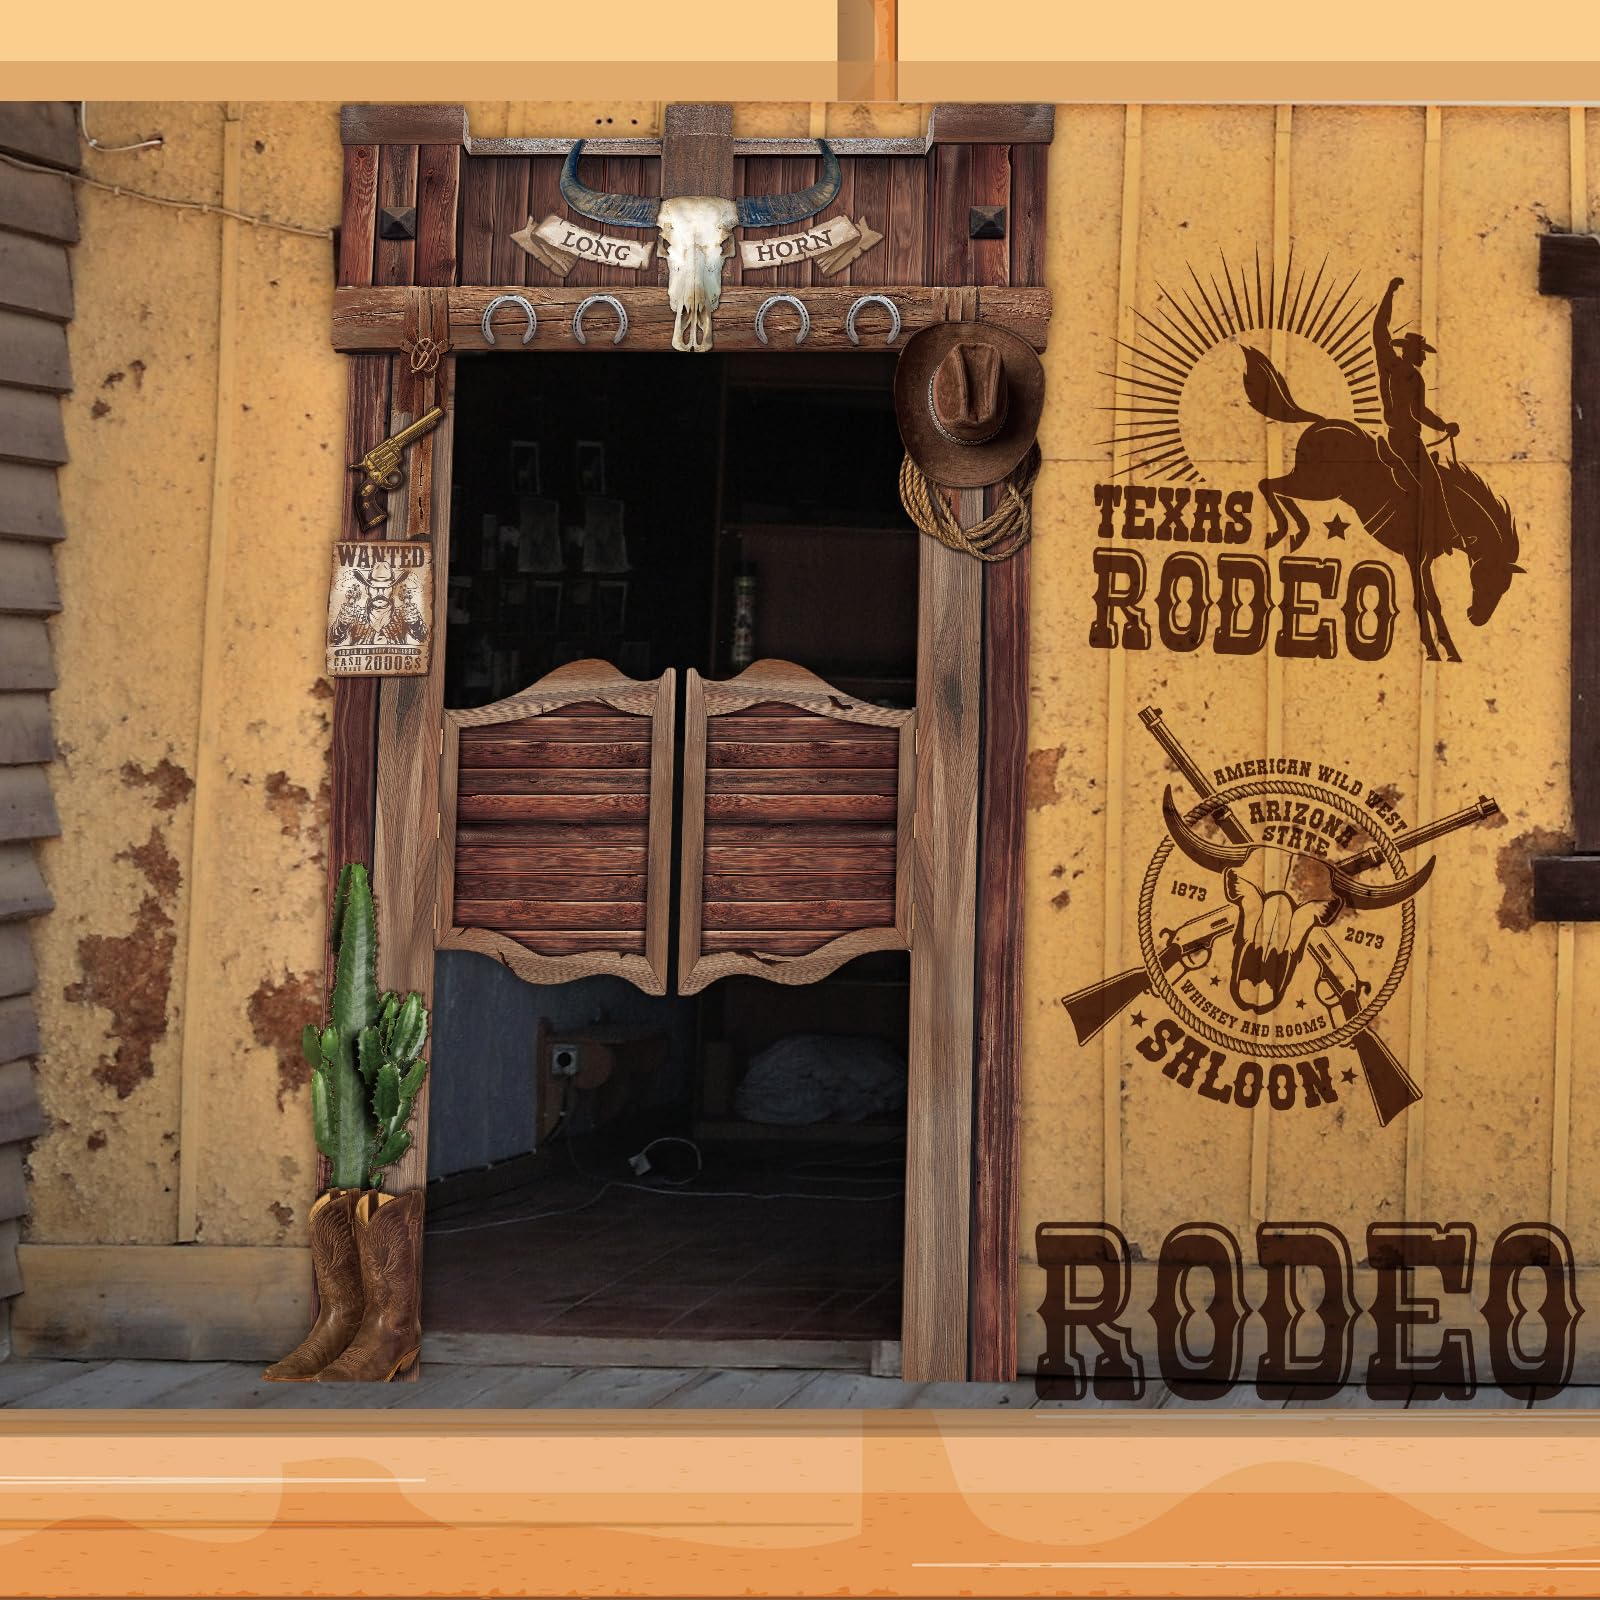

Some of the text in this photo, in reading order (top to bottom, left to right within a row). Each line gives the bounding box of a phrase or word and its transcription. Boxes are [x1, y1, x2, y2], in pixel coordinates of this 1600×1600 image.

[561, 229, 834, 262] LONG HORN
[1094, 484, 1254, 544] TEXAS
[336, 545, 424, 568] WANTED
[1089, 547, 1400, 661] RODEO
[1214, 758, 1408, 834] AMERICAN WILD WEST
[1249, 800, 1357, 849] ARIZONA
[1262, 825, 1331, 857] STATE
[1171, 880, 1208, 902] 1873
[1344, 927, 1385, 949] 2073
[1180, 979, 1327, 1038] WHISKEY AND ROOMS
[1135, 1019, 1338, 1110] SALOON
